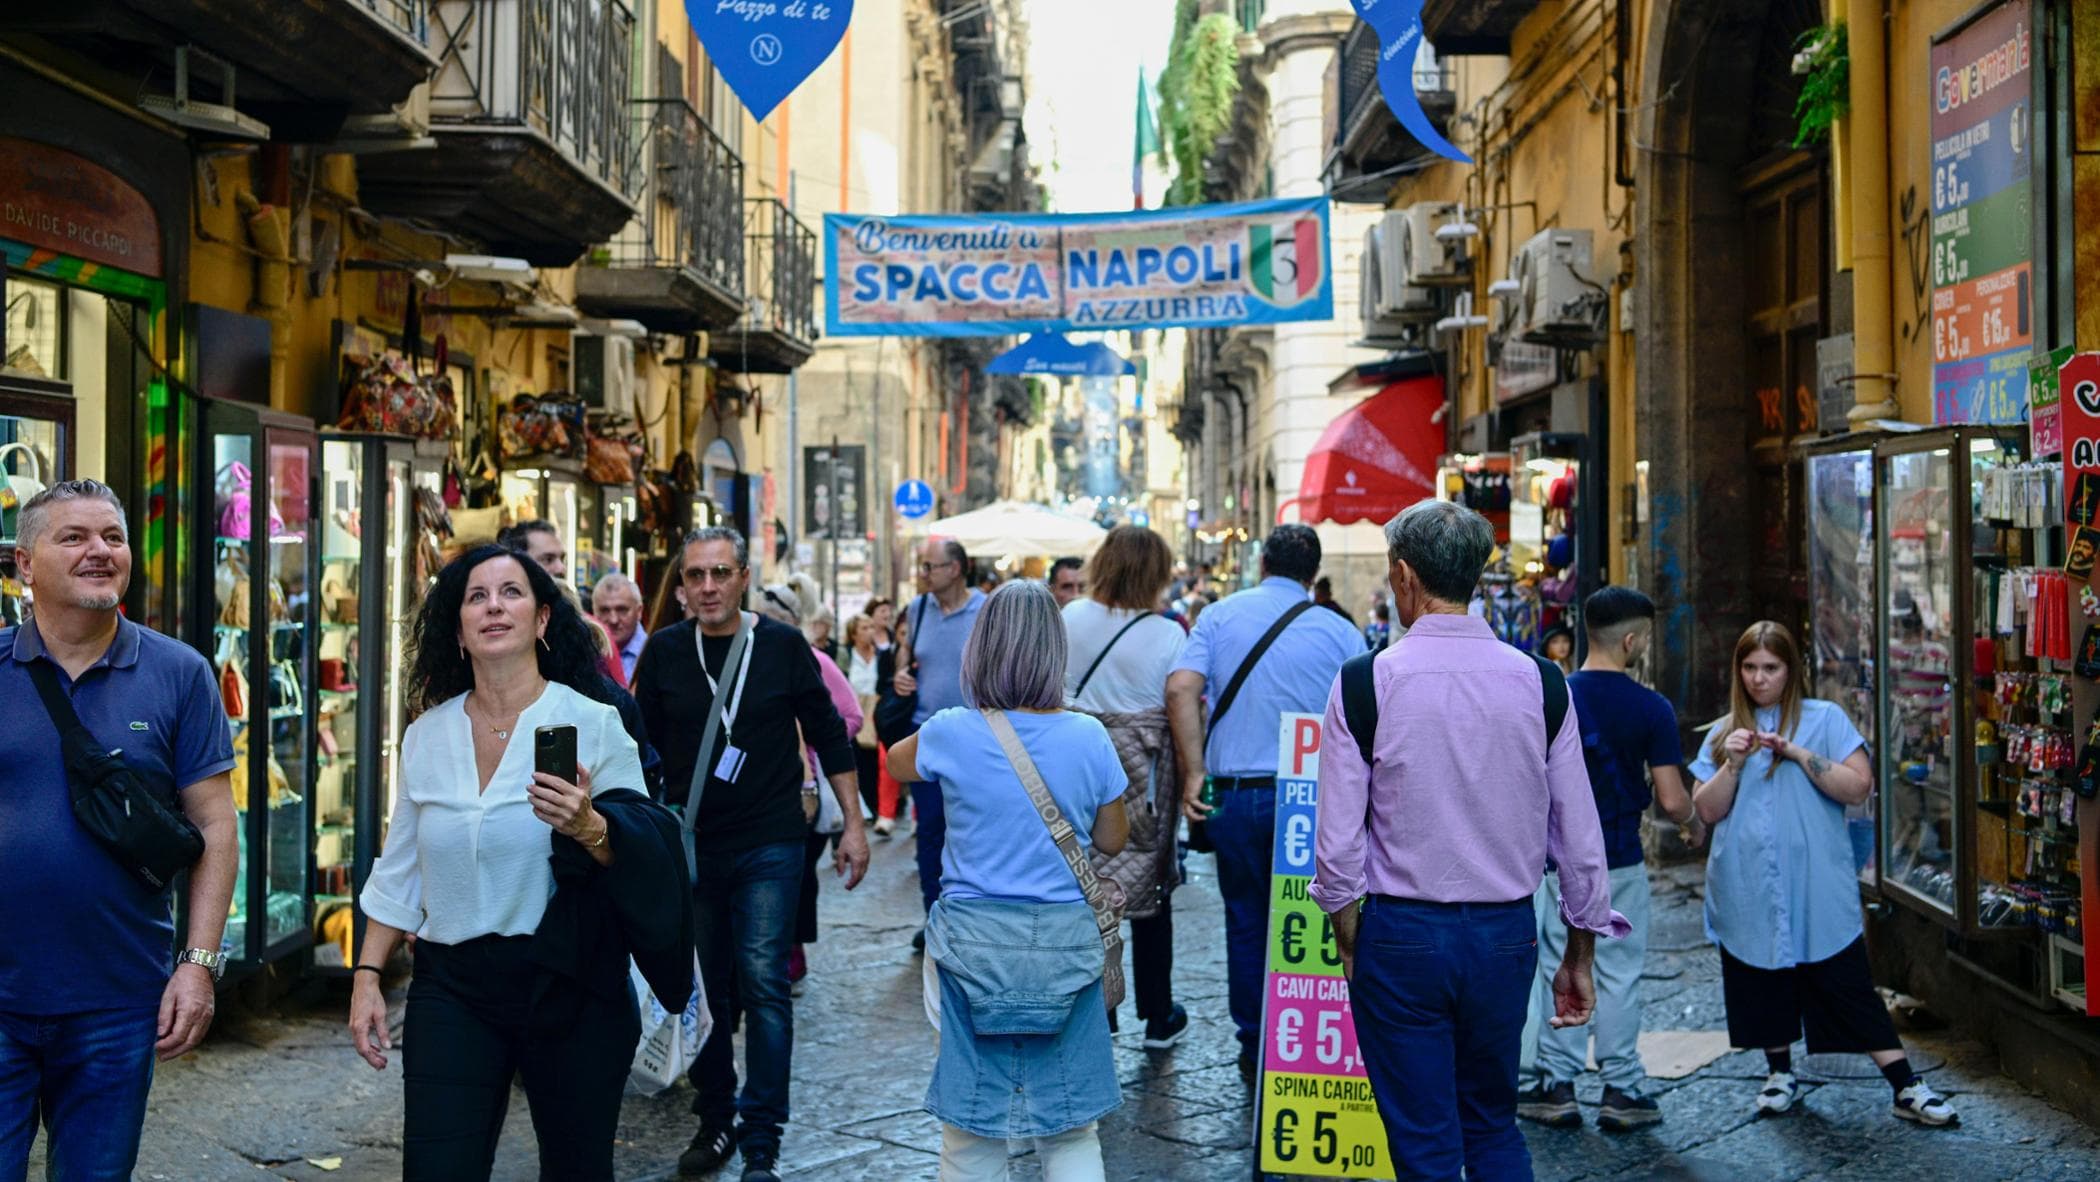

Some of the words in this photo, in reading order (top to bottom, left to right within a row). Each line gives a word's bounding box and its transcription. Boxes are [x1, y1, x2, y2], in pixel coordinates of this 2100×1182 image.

[811, 3, 831, 20] te
[758, 40, 775, 59] N
[1936, 22, 2029, 114] Covermania
[1936, 166, 1946, 210] €
[6, 203, 62, 236] DAVIDE
[856, 220, 1012, 254] Benvenuti
[1020, 233, 1044, 251] a
[853, 261, 1050, 302] SPACCA
[1068, 243, 1241, 289] NAPOLI
[1935, 242, 1945, 285] €
[1075, 296, 1246, 322] AZZURRA
[1935, 317, 1945, 360] €
[2033, 383, 2040, 404] €
[1284, 813, 1312, 867] €
[1281, 911, 1307, 965] €
[1277, 976, 1314, 999] CAVI
[1276, 1007, 1304, 1062] €
[1273, 1076, 1319, 1099] SPINA
[1272, 1108, 1299, 1162] €
[1313, 1110, 1375, 1173] 5,00
